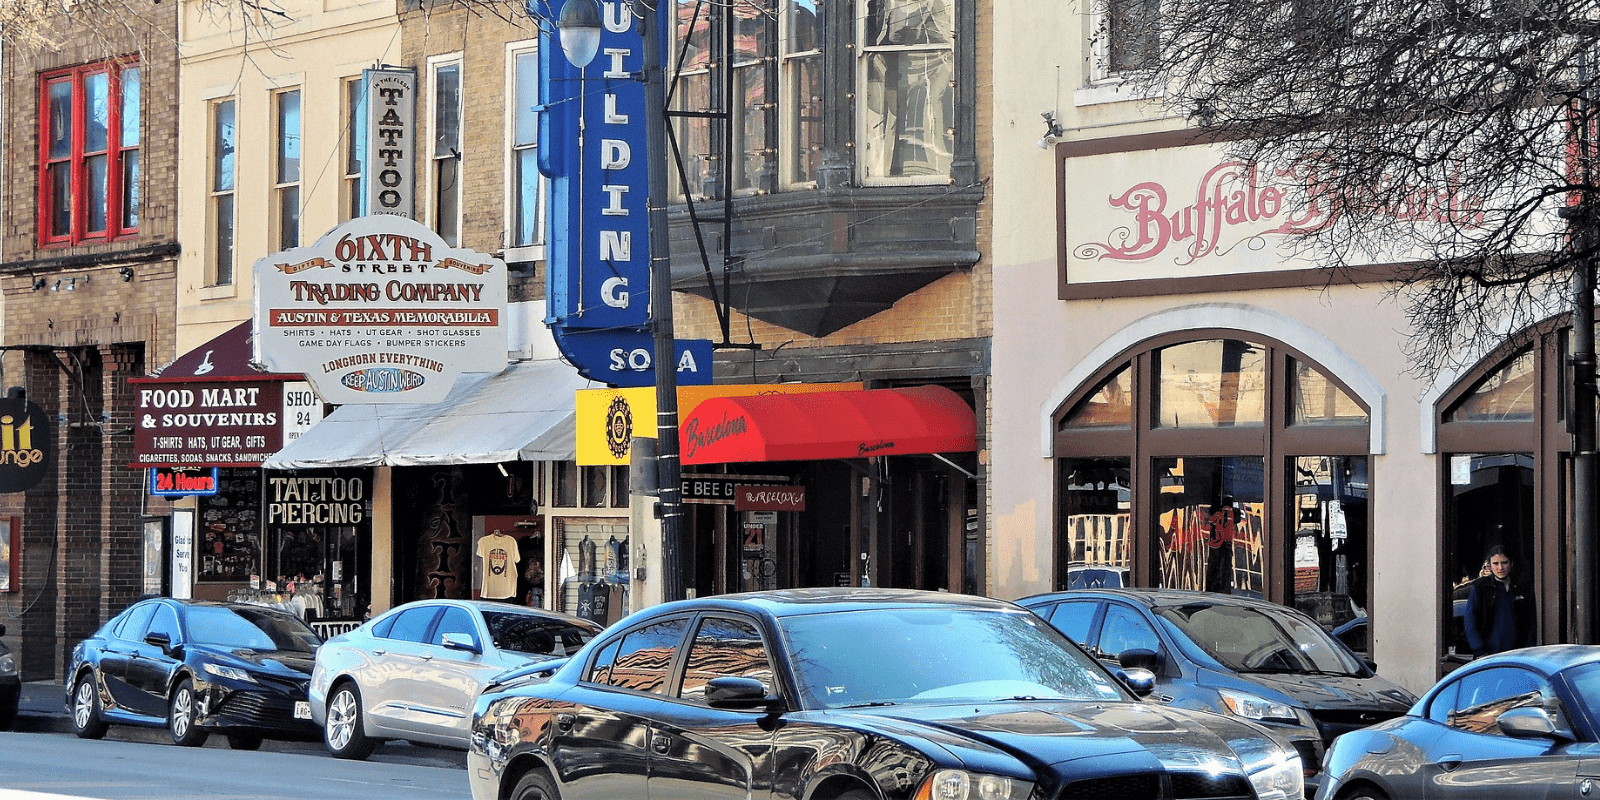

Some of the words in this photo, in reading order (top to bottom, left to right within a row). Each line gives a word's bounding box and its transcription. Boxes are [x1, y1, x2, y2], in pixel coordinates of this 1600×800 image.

[393, 77, 411, 91] FLESH
[378, 87, 404, 208] TATTOO
[600, 2, 632, 309] UILDING
[1096, 161, 1288, 264] Buffalo
[335, 232, 432, 262] 6IXTH
[293, 260, 315, 272] GIFTS
[341, 264, 428, 275] STREET
[289, 280, 381, 305] TRADING
[385, 280, 485, 304] COMPANY
[277, 312, 328, 324] AUSTIN
[330, 312, 341, 324] &
[342, 312, 391, 324] TEXAS
[393, 312, 492, 325] MEMORABILIA
[283, 329, 316, 337] SHIRTS
[329, 329, 352, 337] HATS
[365, 329, 377, 337] UT
[379, 329, 403, 337] GEAR
[416, 329, 440, 337] SHOT
[442, 329, 481, 337] GLASSES
[298, 339, 324, 348] GAME
[326, 339, 342, 347] DAY
[344, 339, 372, 347] FLAGS
[386, 339, 422, 347] BUMPER
[424, 339, 466, 347] STICKERS
[322, 352, 377, 374] LONGHORN
[379, 352, 444, 373] EVERYTHING
[609, 348, 699, 373] SOA
[345, 373, 366, 388] KEEP
[365, 369, 399, 392] AUSTIN
[399, 371, 424, 392] WEIRD
[140, 389, 195, 409] FOOD
[200, 387, 260, 408] MART
[141, 414, 157, 429] &
[162, 412, 277, 427] SOUVENIRS
[296, 411, 311, 426] 24
[153, 436, 183, 449] T-SHIRTS
[188, 436, 208, 450] HATS,
[211, 436, 221, 448] UT
[221, 436, 242, 450] GEAR,
[245, 435, 266, 448] GIFTS
[684, 410, 748, 459] Barcelona
[857, 439, 896, 456] Barcelona
[139, 453, 180, 464] CIGARETTES,
[206, 453, 233, 463] SNACKS,
[234, 452, 275, 462] SANDWICHE
[156, 472, 174, 490] 24
[175, 472, 215, 490] Hours
[269, 477, 363, 502] TATTOO
[693, 481, 720, 497] BEE
[745, 491, 805, 506] BARCELONA
[268, 502, 363, 525] PIERCING
[174, 535, 186, 545] Glad
[744, 529, 764, 547] 21
[176, 548, 190, 559] Serve
[178, 562, 188, 573] You
